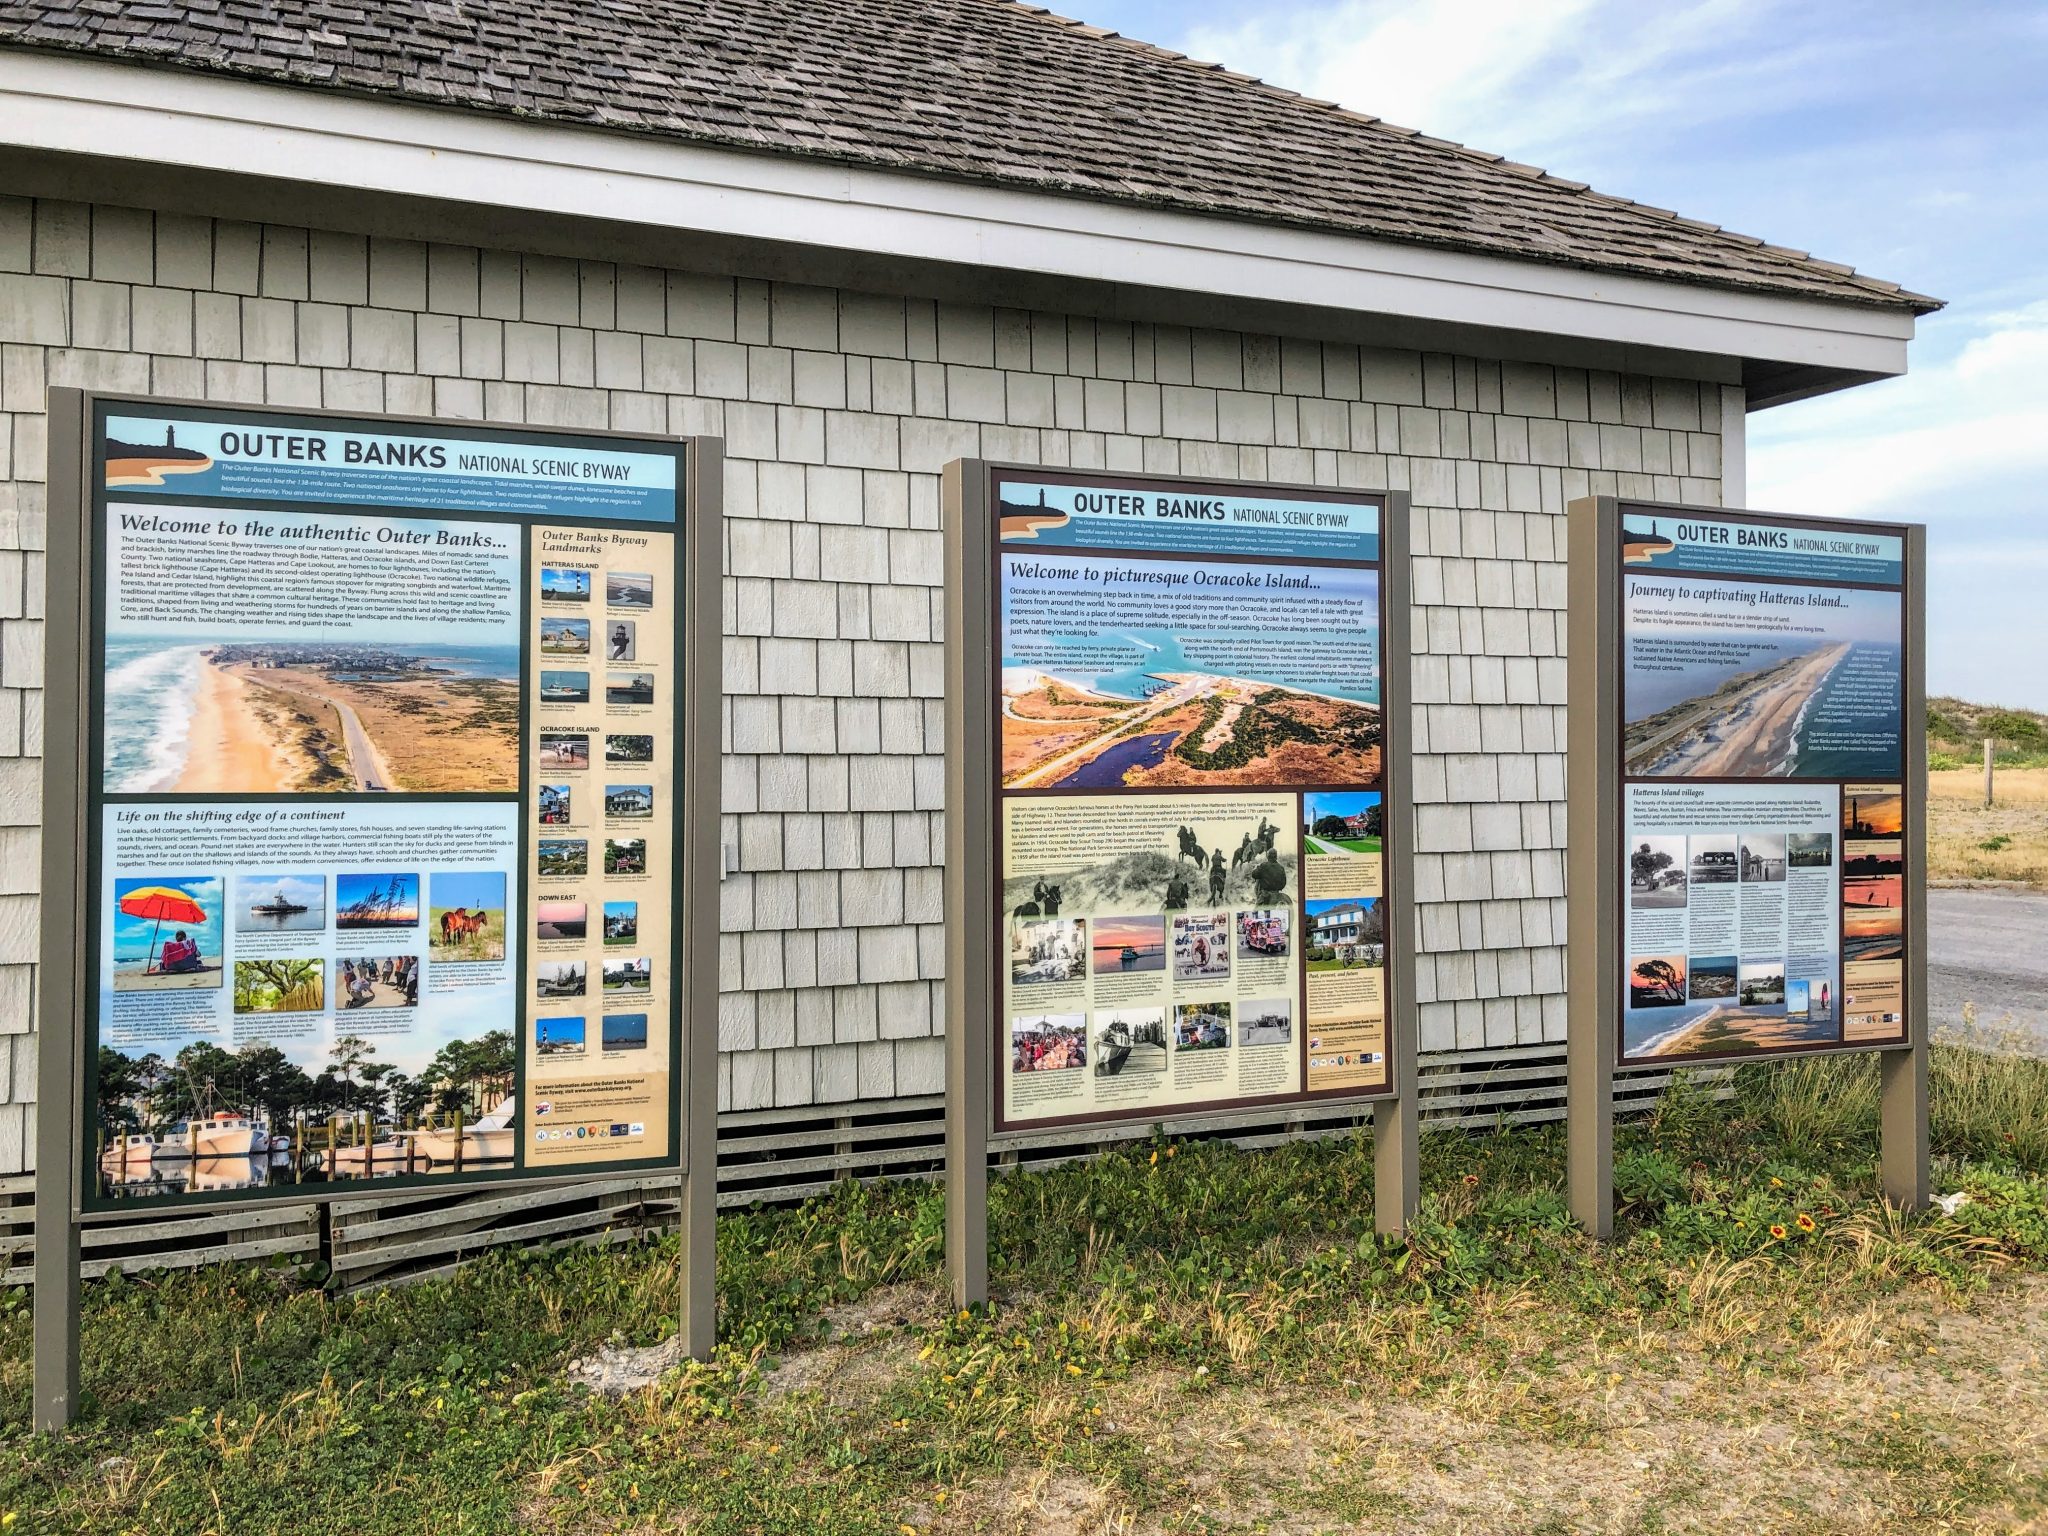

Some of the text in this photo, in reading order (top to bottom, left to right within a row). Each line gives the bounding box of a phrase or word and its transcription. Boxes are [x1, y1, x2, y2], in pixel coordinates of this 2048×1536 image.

[220, 432, 447, 468] OUTER BANKS
[459, 454, 631, 480] NATIONAL SCENIC BYWAY
[1074, 493, 1225, 520] OUTER BANKS
[1233, 509, 1349, 527] NATIONAL SCENIC BYWAY
[121, 514, 506, 547] Welcome to the authentic Outer Banks...
[542, 531, 648, 547] Outer Banks Byway
[1677, 524, 1788, 548] OUTER BANKS
[231, 541, 253, 549] Byway
[542, 542, 602, 553] Landmarks
[1793, 538, 1880, 555] NATIONAL SCENIC BYWAY
[1010, 563, 1321, 589] Welcome to picturesque Ocracoke Island...
[1056, 589, 1103, 598] overwhelming
[1103, 591, 1117, 599] step
[1234, 595, 1269, 604] community
[1269, 596, 1284, 605] spirit
[1325, 598, 1344, 606] steady
[1630, 582, 1849, 607] Journey to captivating Hatteras Island...
[1010, 628, 1022, 636] just
[1041, 628, 1063, 637] they're
[1063, 629, 1088, 638] looking
[1681, 789, 1705, 798] villages
[117, 811, 141, 824] Life
[164, 811, 183, 820] the
[186, 811, 232, 823] shifting
[235, 810, 262, 823] edge
[265, 810, 279, 823] of
[290, 810, 345, 820] continent
